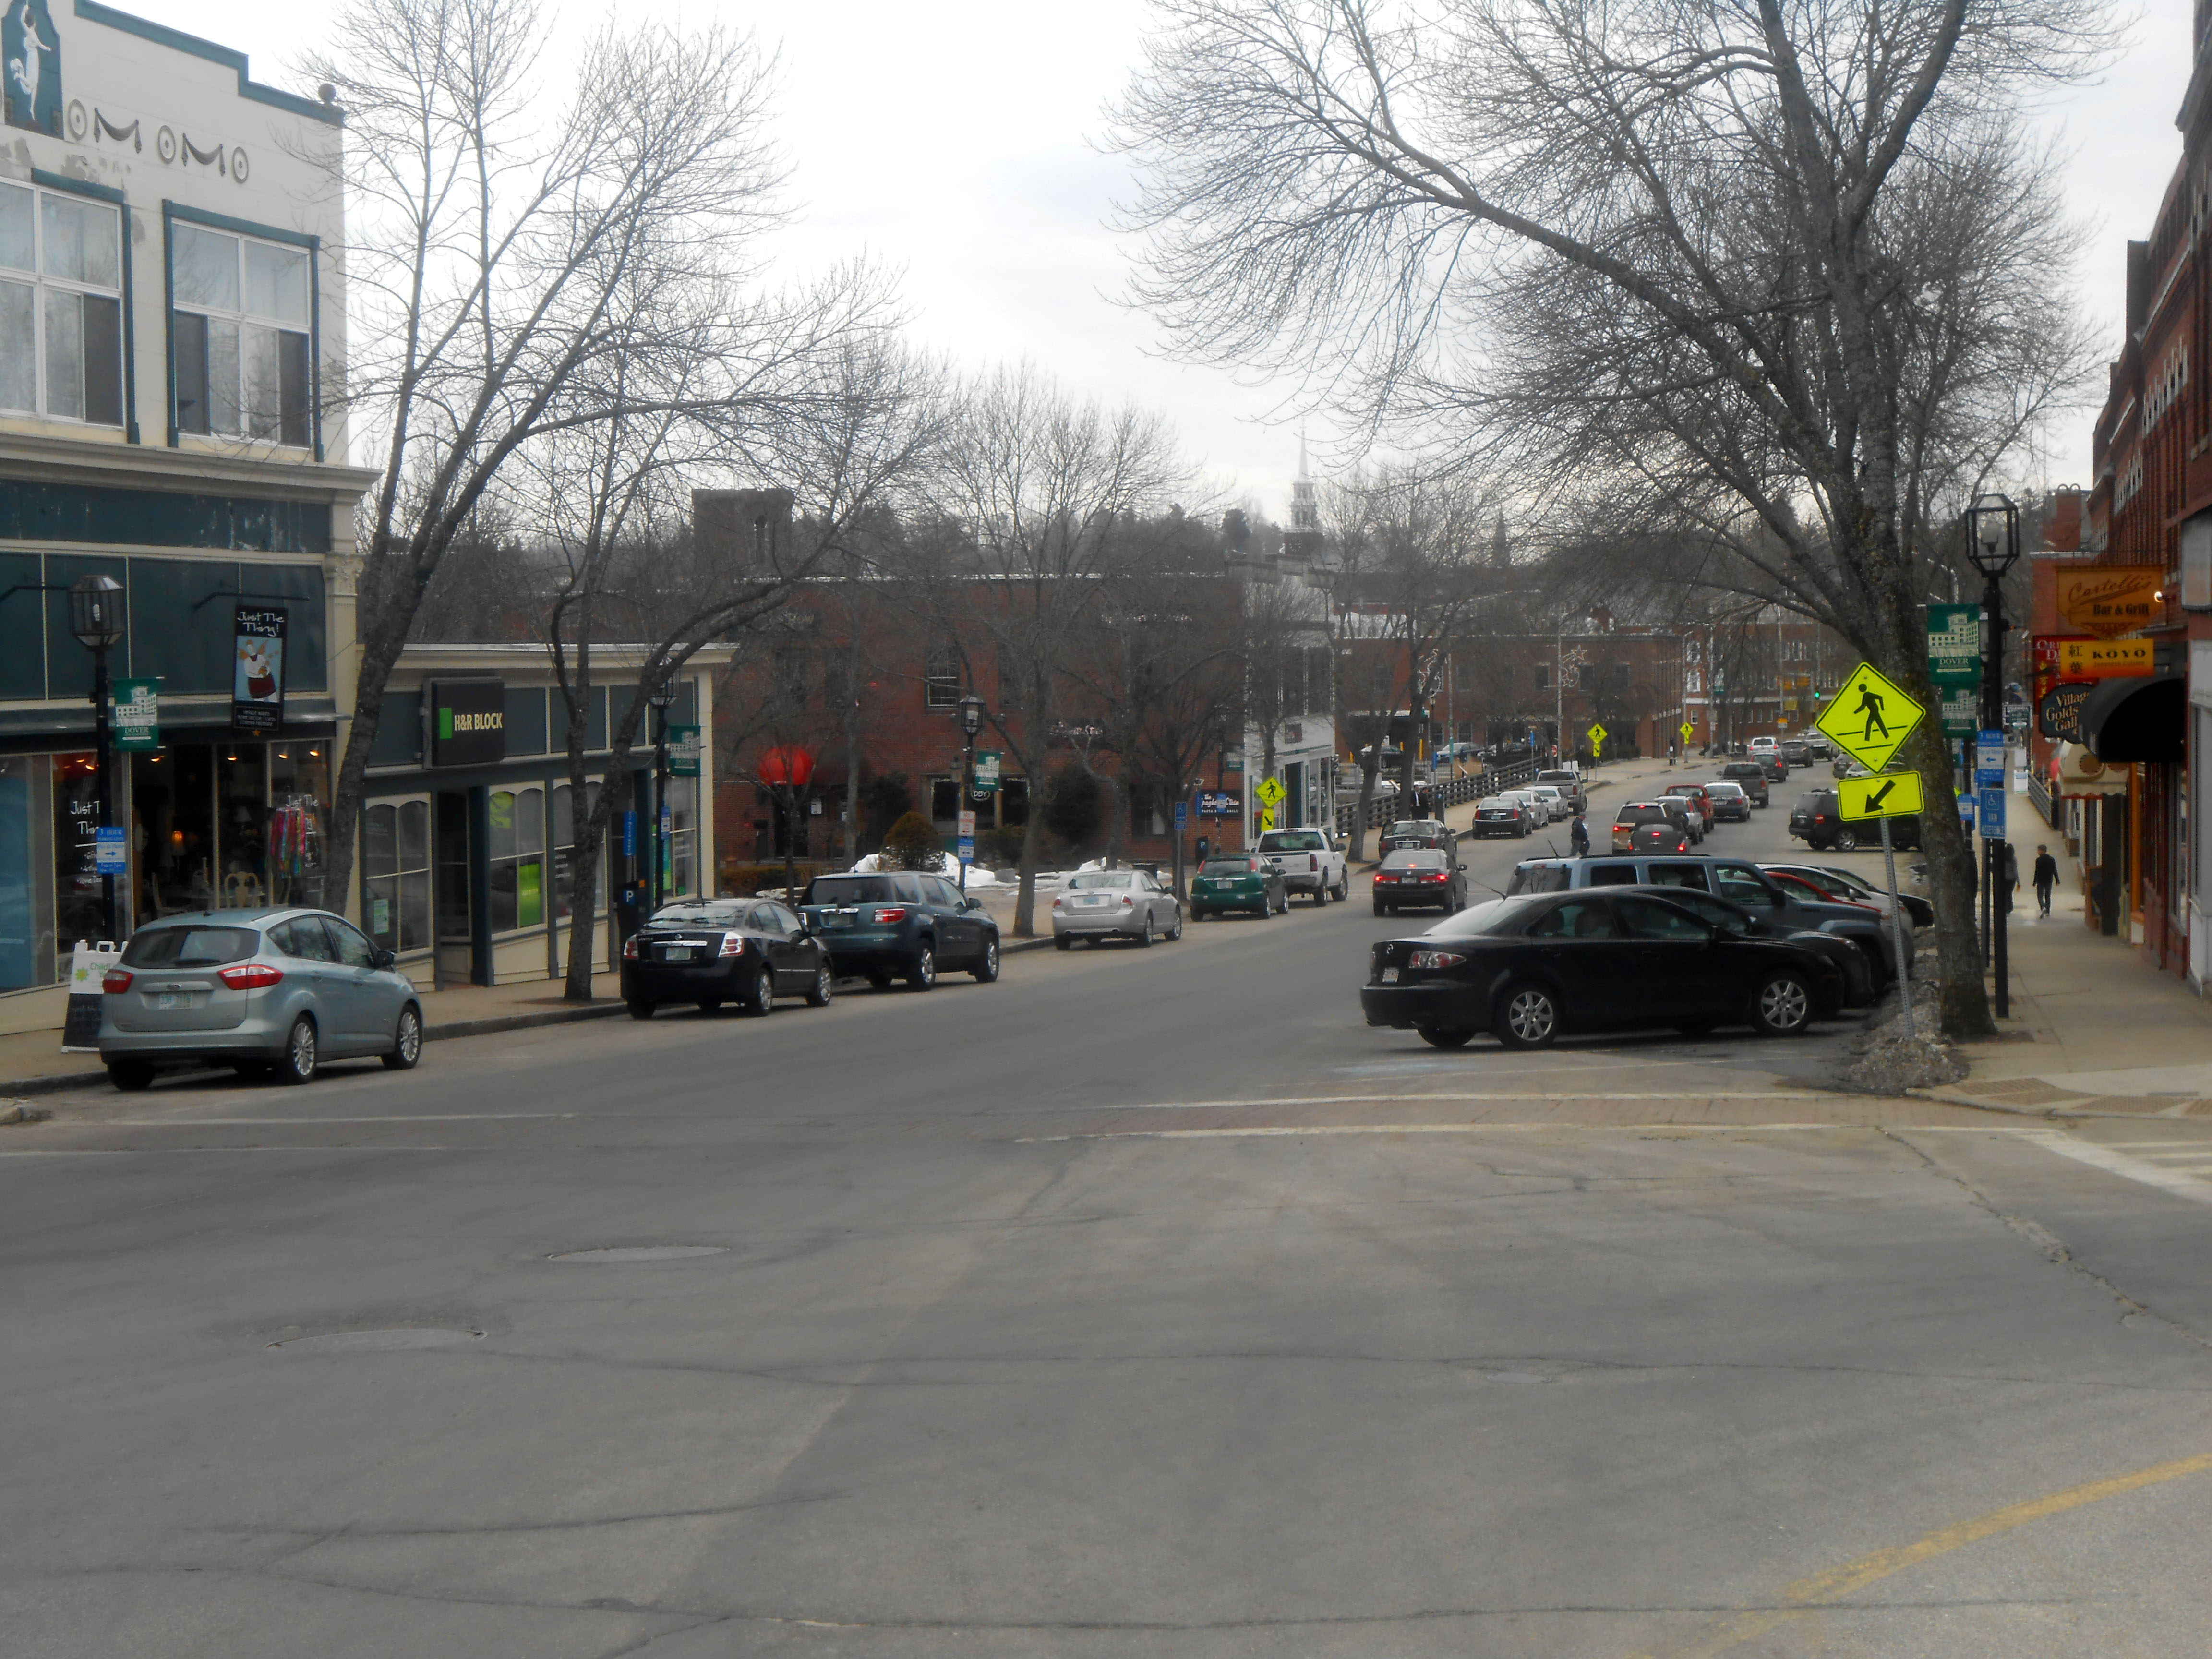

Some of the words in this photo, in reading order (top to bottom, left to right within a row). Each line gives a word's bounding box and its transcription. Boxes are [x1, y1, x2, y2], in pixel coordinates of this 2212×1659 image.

[2093, 603, 2112, 615] Bar
[2115, 604, 2123, 615] &
[2126, 603, 2149, 615] Grill
[237, 611, 261, 622] Just
[263, 613, 284, 622] The
[242, 622, 279, 637] Thing!
[2056, 692, 2090, 707] Villag
[2046, 705, 2080, 721] Golds
[454, 714, 473, 731] H&R
[474, 712, 503, 730] BLOCK
[2055, 716, 2078, 732] Gall
[71, 801, 92, 815] Just
[1988, 813, 1998, 822] VAN
[1982, 825, 2005, 835] ACCESSIBLE
[626, 890, 634, 902] P
